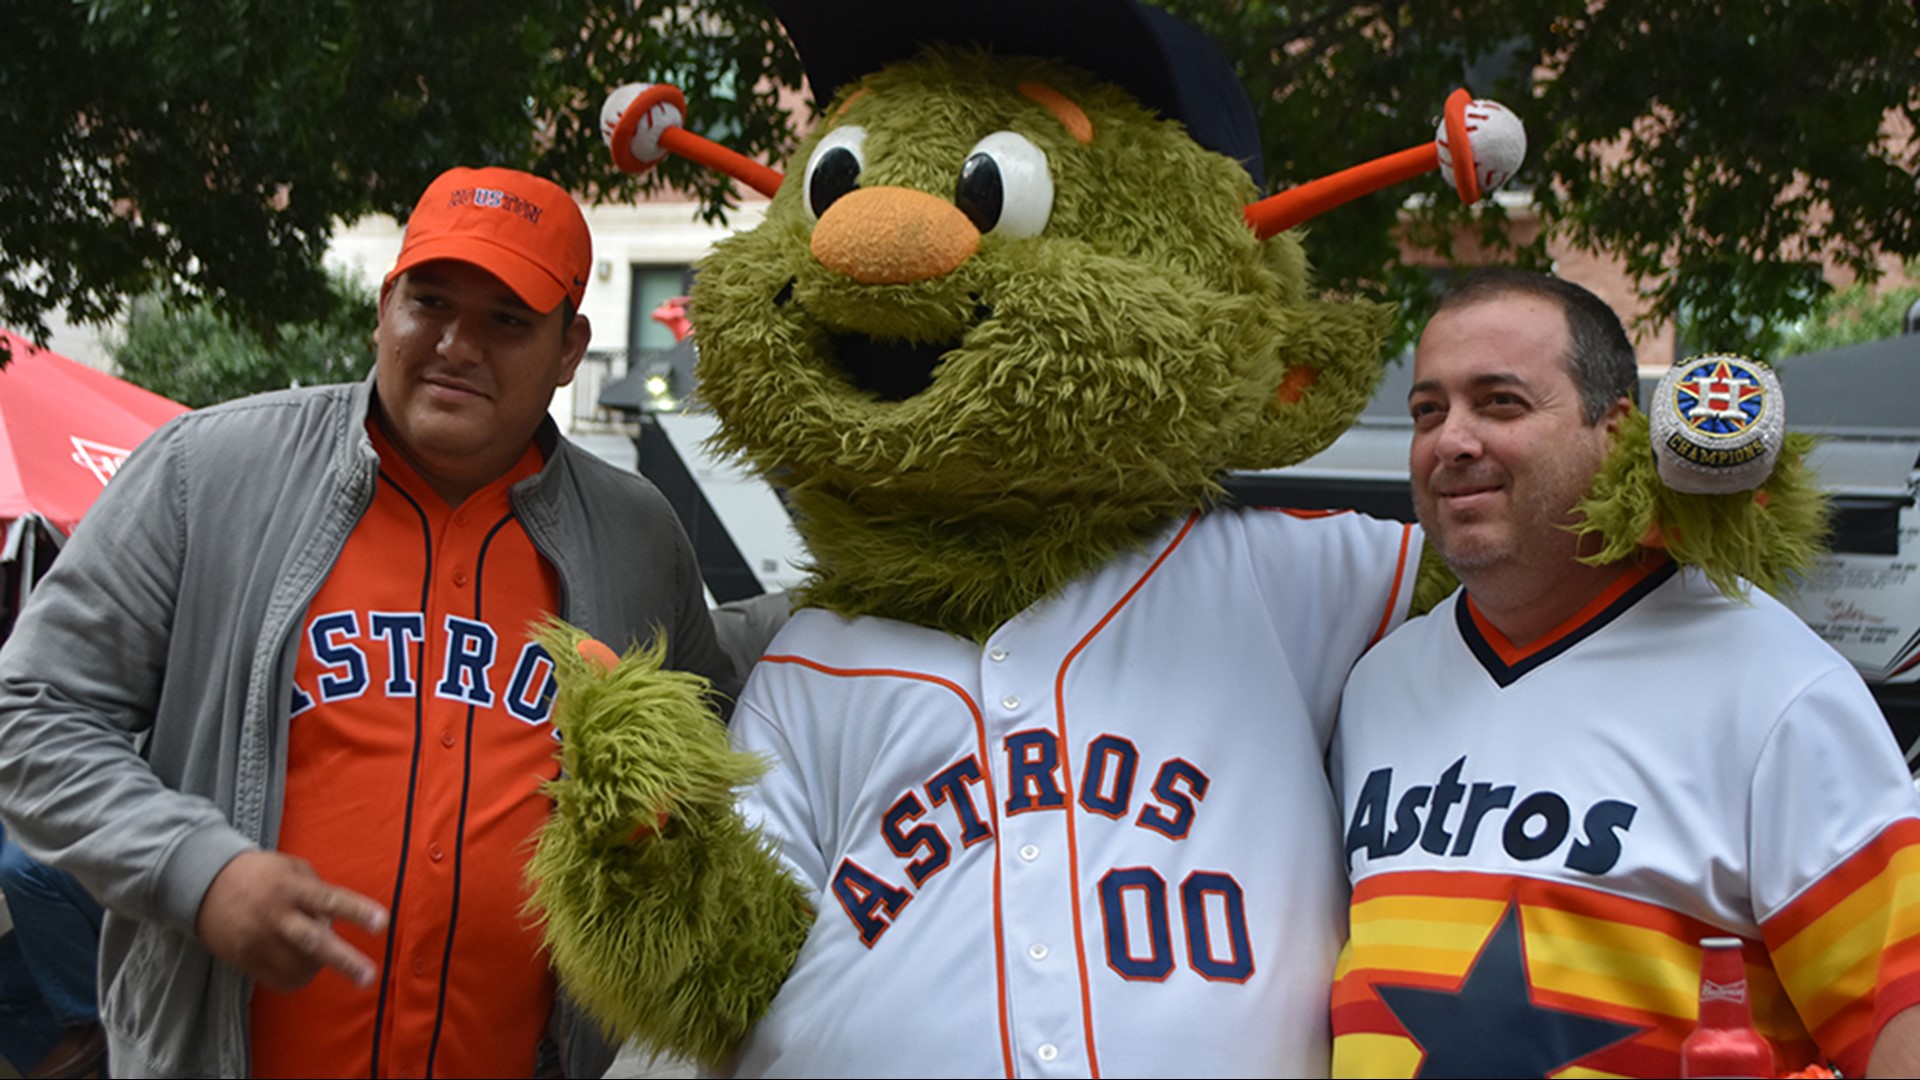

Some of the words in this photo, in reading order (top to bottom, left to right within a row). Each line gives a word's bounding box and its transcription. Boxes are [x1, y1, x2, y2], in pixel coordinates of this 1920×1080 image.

[1668, 433, 1765, 465] CHAMPIONS
[290, 610, 563, 741] STRO
[831, 727, 1211, 949] ASTROS
[1345, 754, 1638, 876] Astros
[1097, 866, 1256, 984] 00
